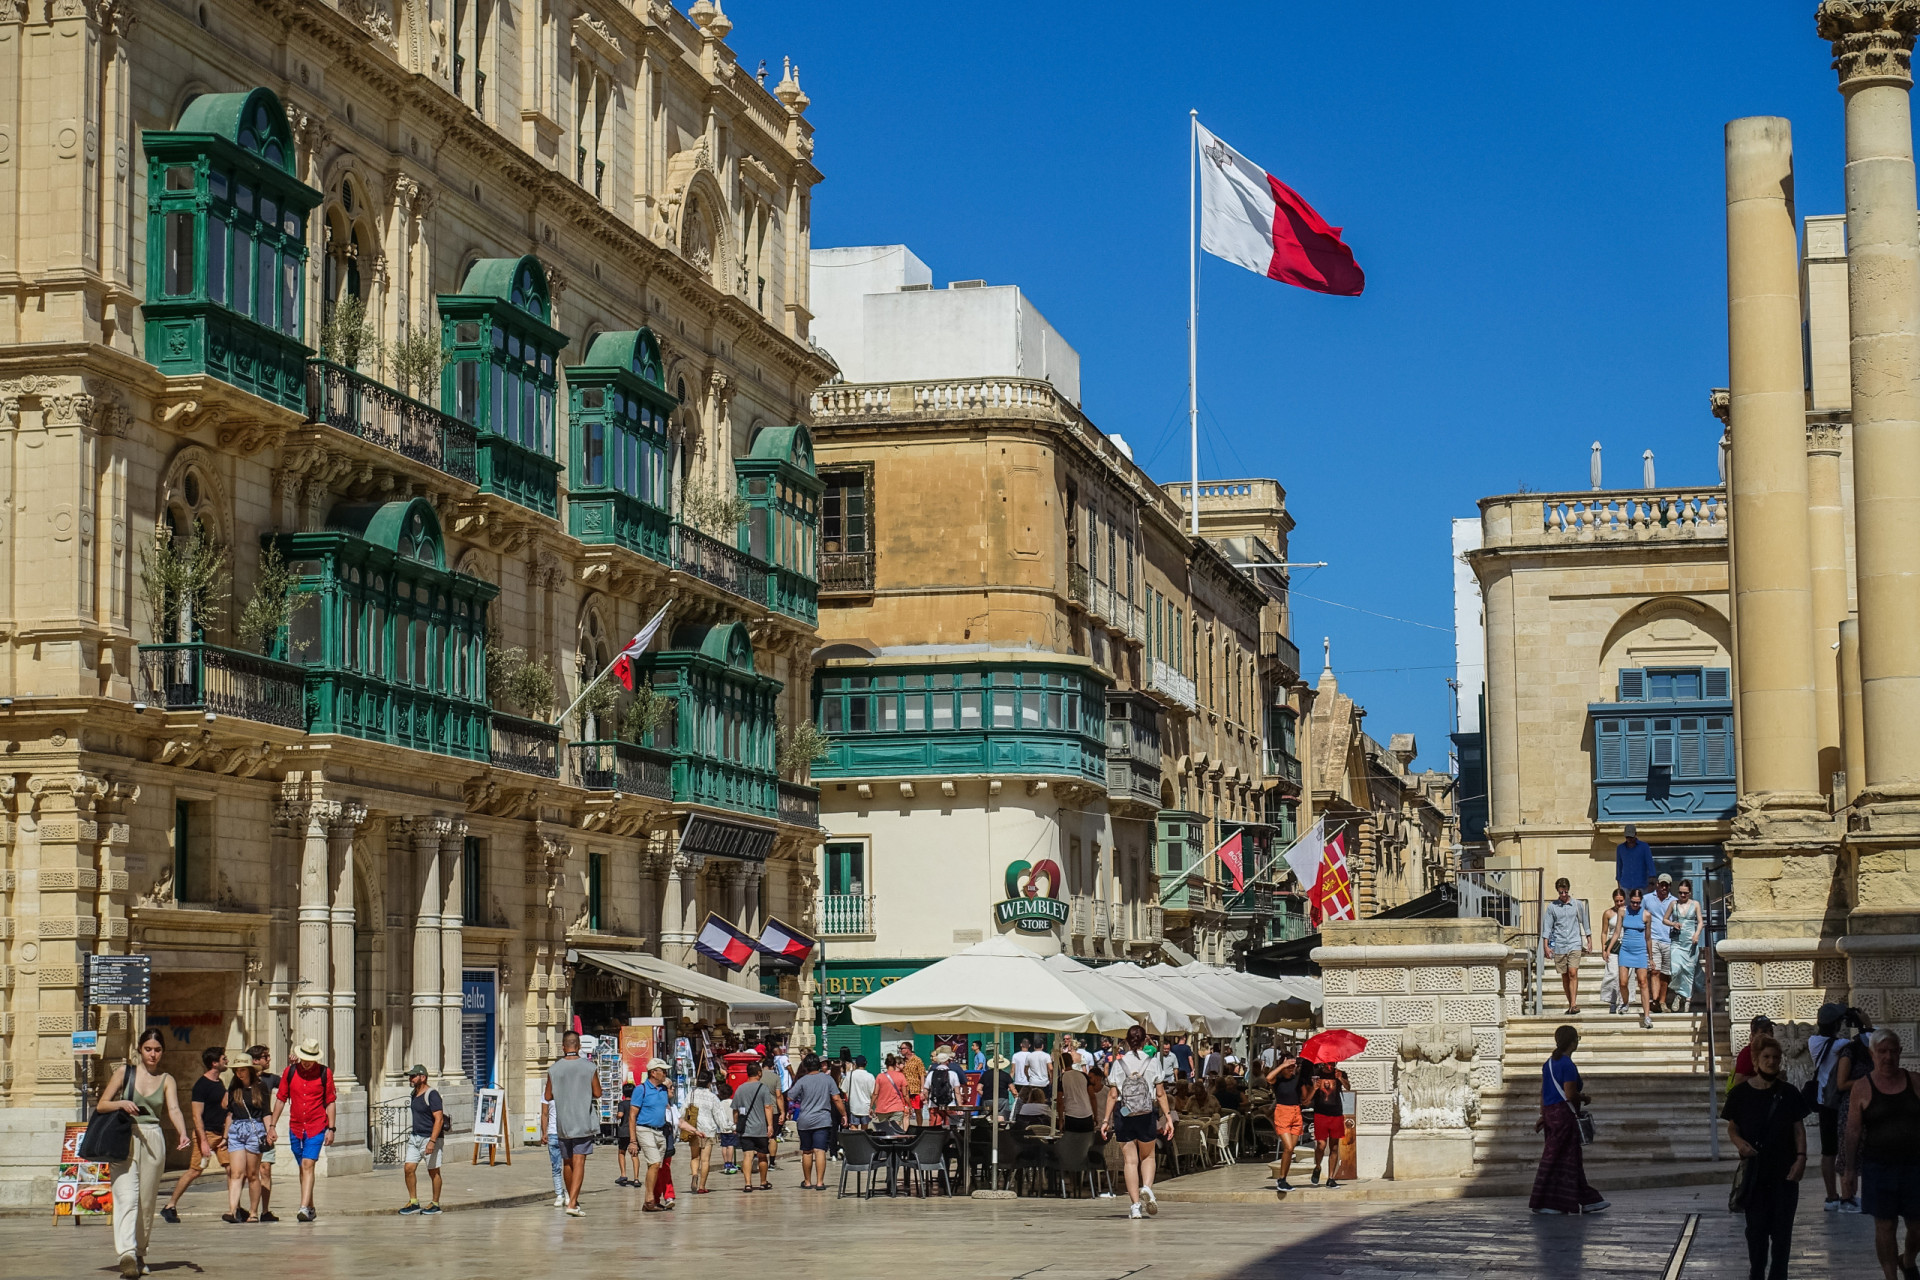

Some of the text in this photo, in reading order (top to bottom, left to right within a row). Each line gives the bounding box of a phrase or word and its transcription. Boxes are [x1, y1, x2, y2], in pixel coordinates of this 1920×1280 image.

[705, 824, 743, 855] BATTA
[1000, 900, 1067, 921] WEMBLEY
[1021, 919, 1049, 929] STORE
